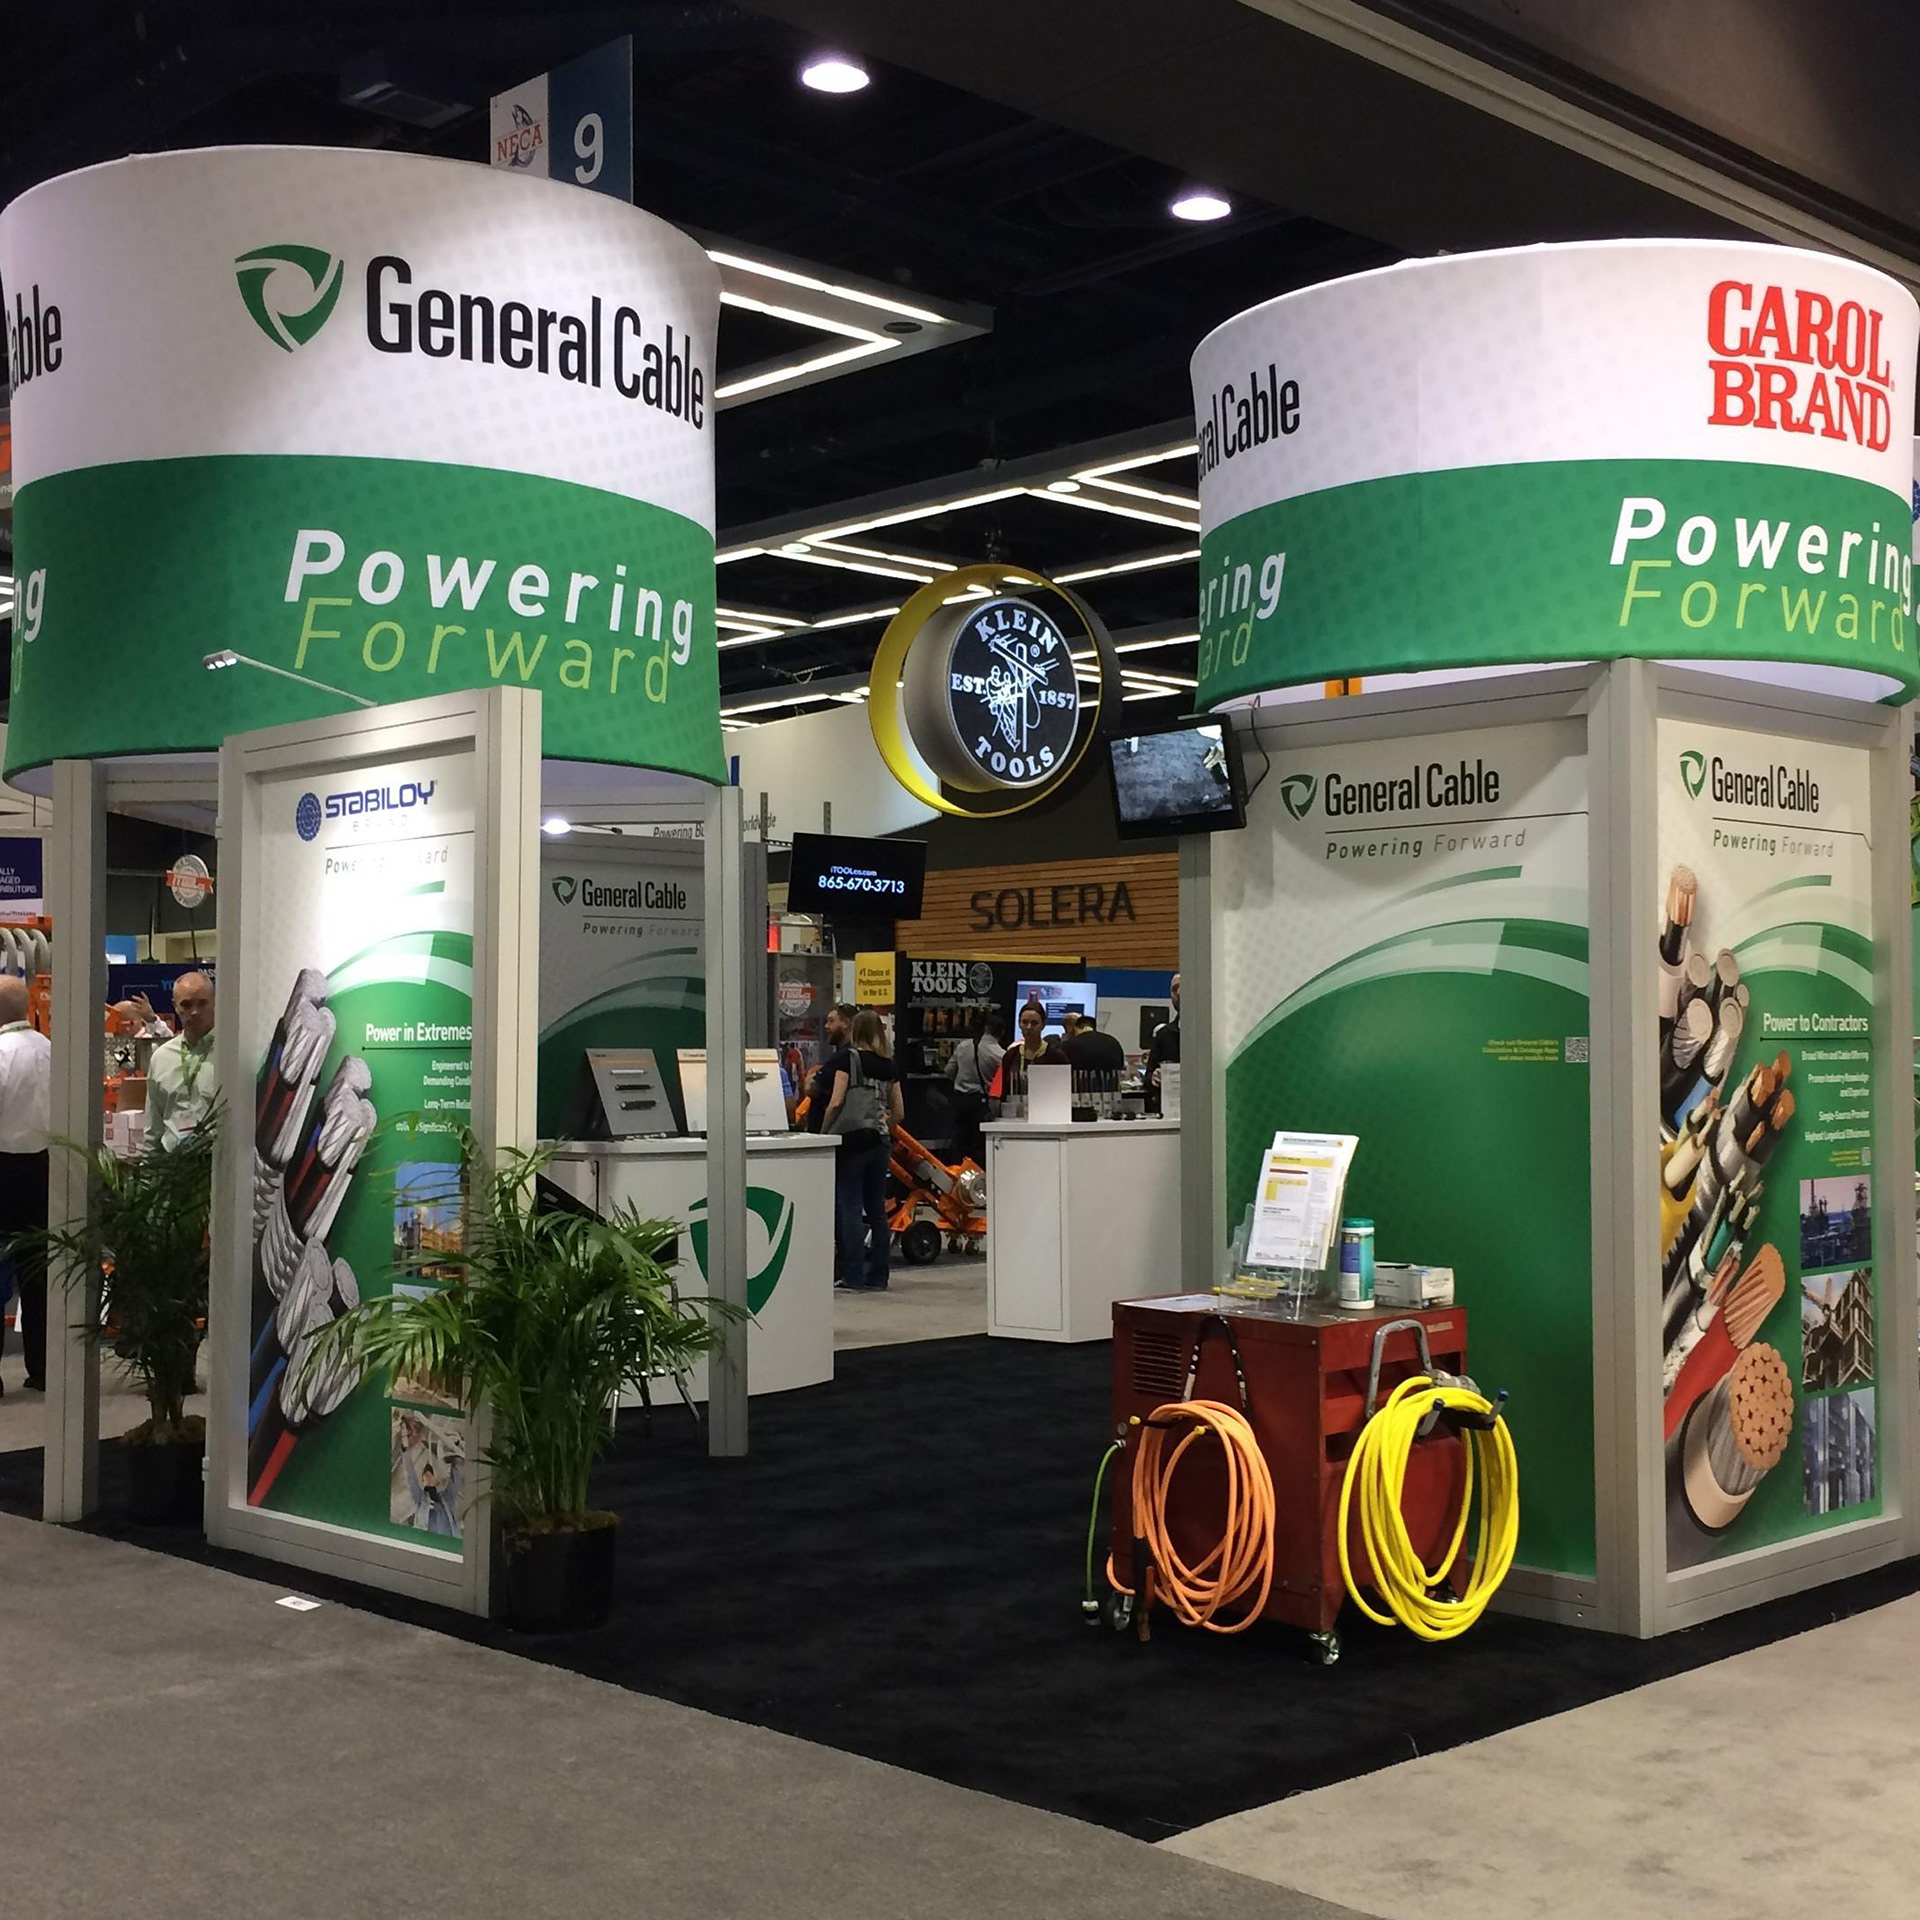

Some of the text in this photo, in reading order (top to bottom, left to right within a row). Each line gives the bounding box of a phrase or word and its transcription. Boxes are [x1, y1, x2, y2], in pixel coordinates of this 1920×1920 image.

[497, 124, 543, 162] NECA
[574, 112, 604, 184] 9
[366, 255, 704, 431] General Cable
[1707, 280, 1890, 388] CAROL
[1222, 363, 1300, 459] Cable
[1707, 360, 1891, 453] BRAND
[1609, 497, 1912, 616] Powering
[284, 529, 693, 666] Powering
[1619, 560, 1905, 652] Forward
[975, 609, 1058, 653] KLEIN
[294, 597, 670, 704] Forward
[951, 673, 987, 695] EST.
[1038, 690, 1075, 710] 1857
[975, 735, 1054, 778] TOOLS
[325, 780, 435, 819] STABILOY
[1324, 759, 1500, 817] General Cable
[1712, 757, 1819, 813] General Cable
[1326, 829, 1526, 860] Powering Forward
[1713, 829, 1834, 858] Powering Forward
[582, 878, 687, 910] General Cable
[818, 875, 905, 894] 865-670-3713
[970, 881, 1136, 932] SOLERA
[583, 922, 700, 938] Powering Forward
[911, 961, 968, 978] KLEIN
[911, 977, 968, 994] TOOLS
[366, 1022, 473, 1042] Power in Extremes
[1763, 1012, 1869, 1032] Power to Contractors
[423, 1075, 454, 1088] Demanding
[432, 1060, 463, 1073] Engineered
[424, 1099, 455, 1111] Long-Term
